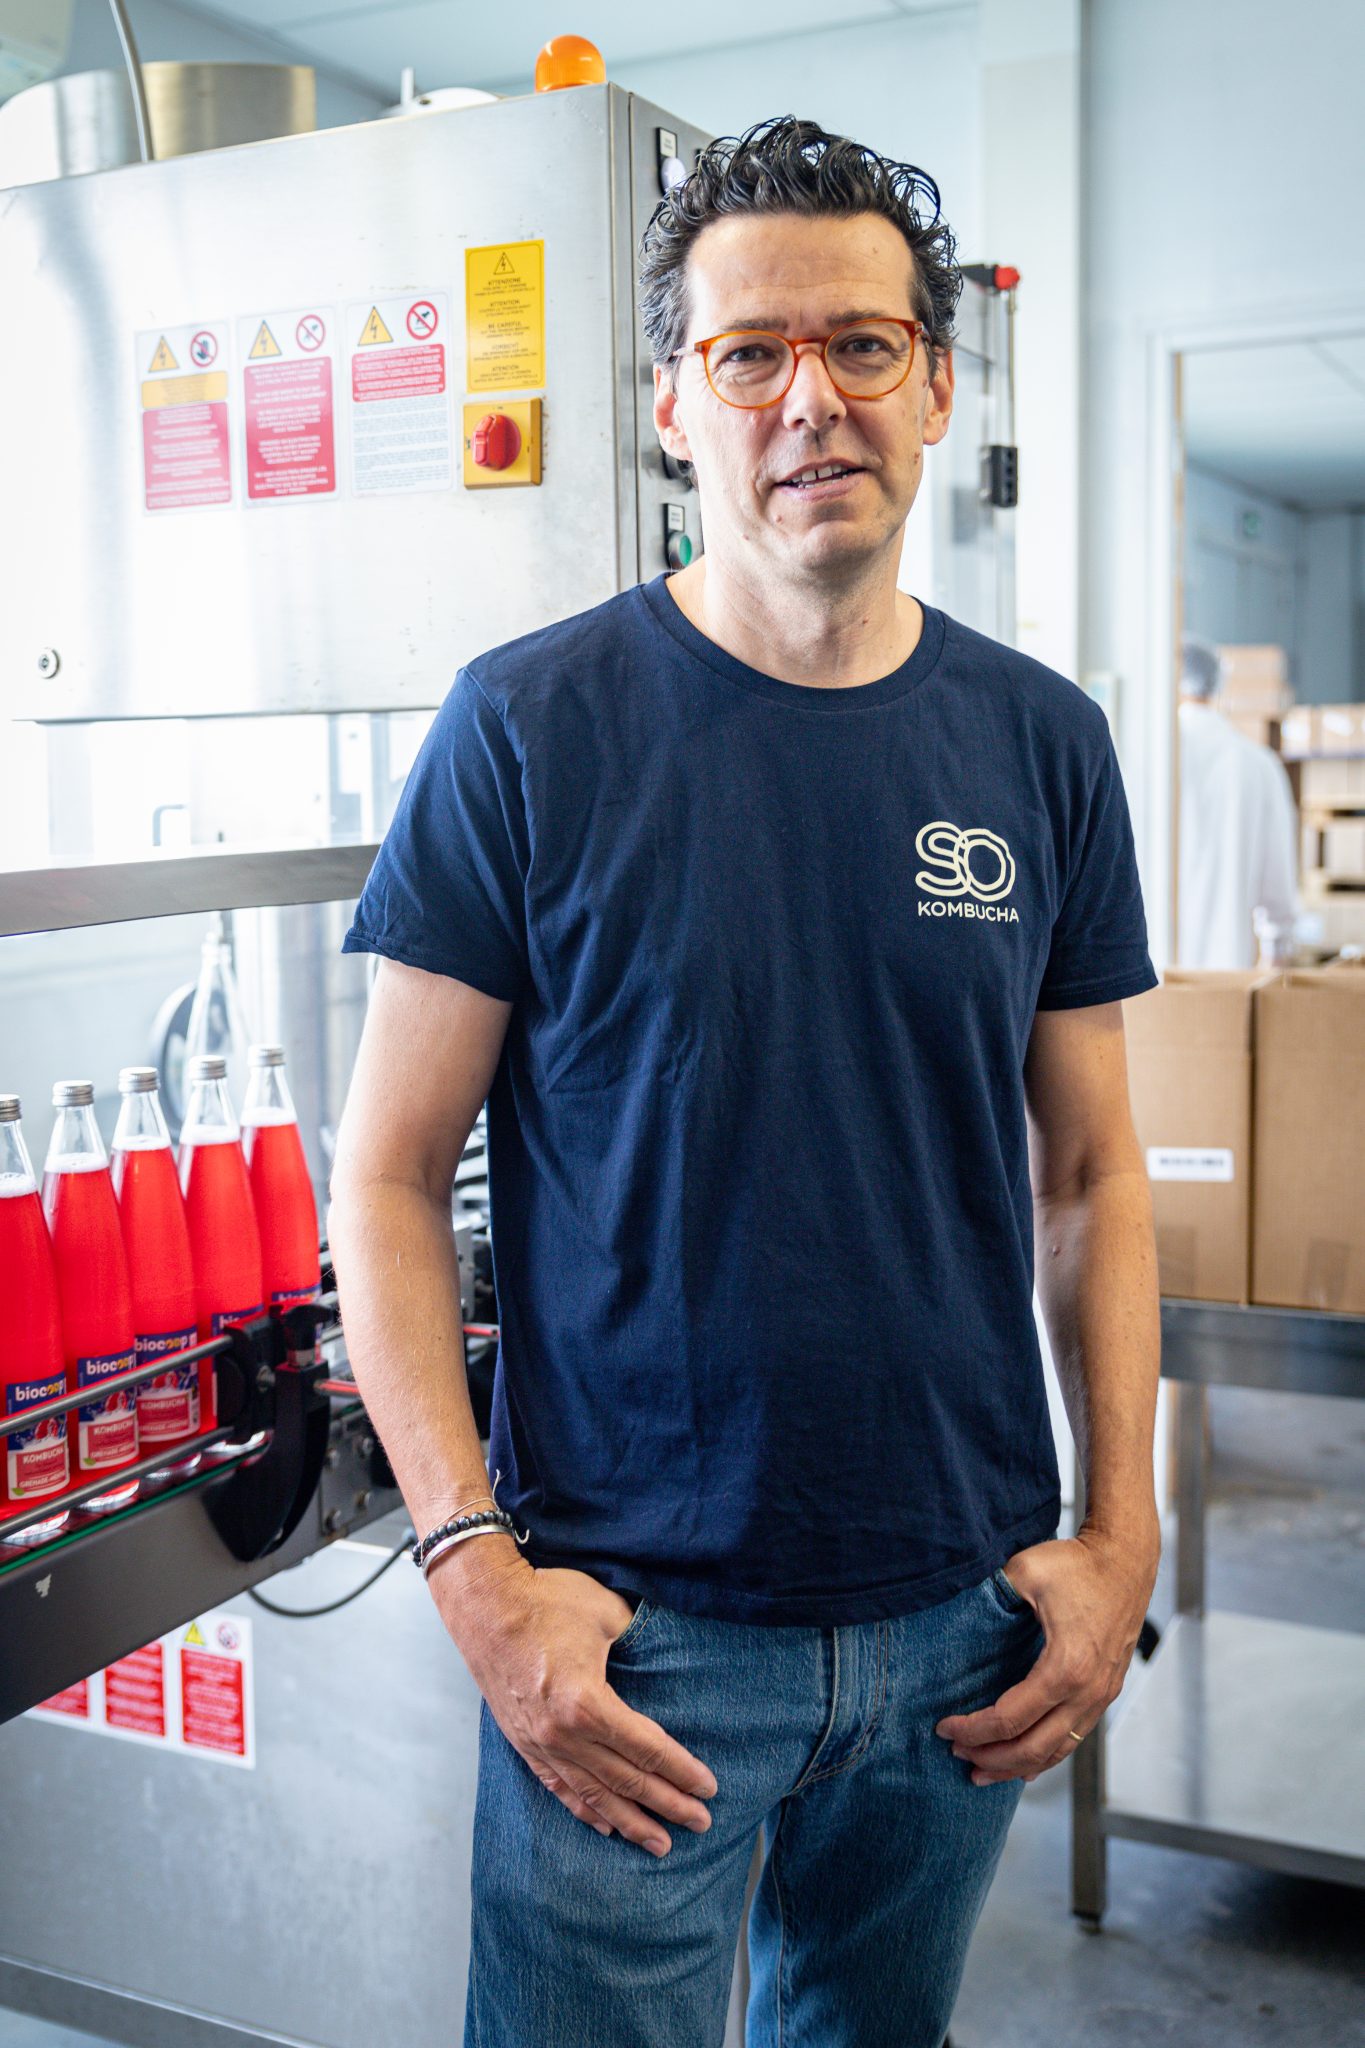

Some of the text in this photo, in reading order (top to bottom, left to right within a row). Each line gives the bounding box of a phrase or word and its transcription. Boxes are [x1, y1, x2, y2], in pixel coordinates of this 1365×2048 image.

[915, 821, 1015, 902] SO
[917, 901, 1020, 923] KOMBUCHA
[135, 1336, 188, 1351] biocoop
[86, 1355, 134, 1375] biocoop
[15, 1380, 64, 1401] biocoop
